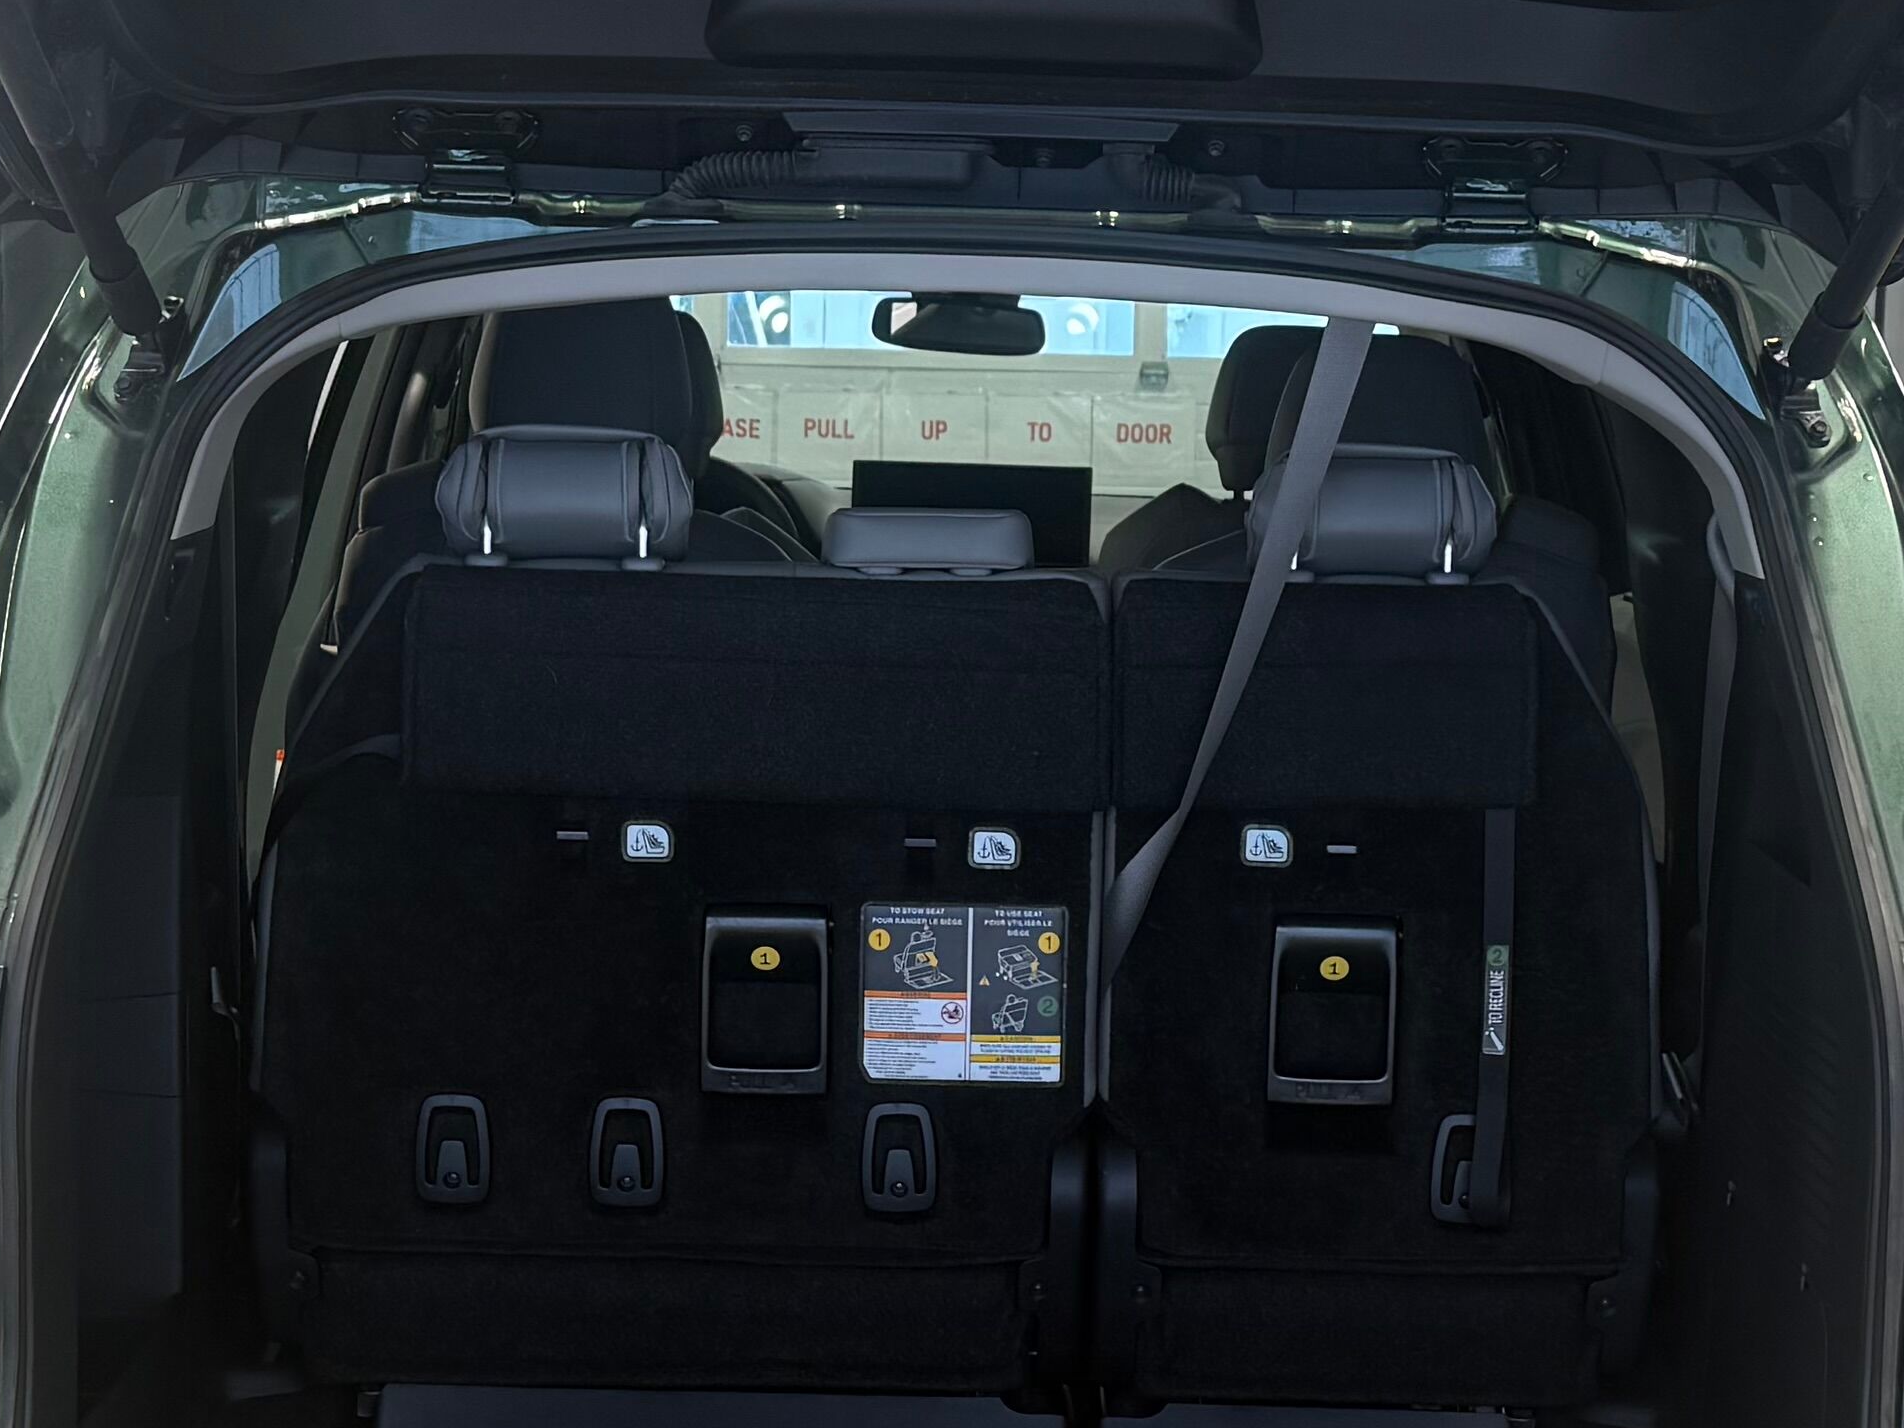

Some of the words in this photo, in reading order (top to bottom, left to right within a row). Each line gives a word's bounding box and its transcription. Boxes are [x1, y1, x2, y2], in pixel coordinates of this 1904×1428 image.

[803, 417, 855, 439] PULL
[921, 419, 948, 440] UP
[1027, 422, 1052, 442] TO
[1116, 422, 1172, 444] DOOR
[875, 933, 882, 947] 1
[1044, 936, 1052, 950] 1
[760, 953, 771, 965] 1
[1492, 948, 1503, 964] 2
[1328, 962, 1340, 975] 1
[1489, 970, 1504, 1011] RECLINE
[1042, 1000, 1053, 1011] 2
[1488, 1012, 1503, 1025] TO
